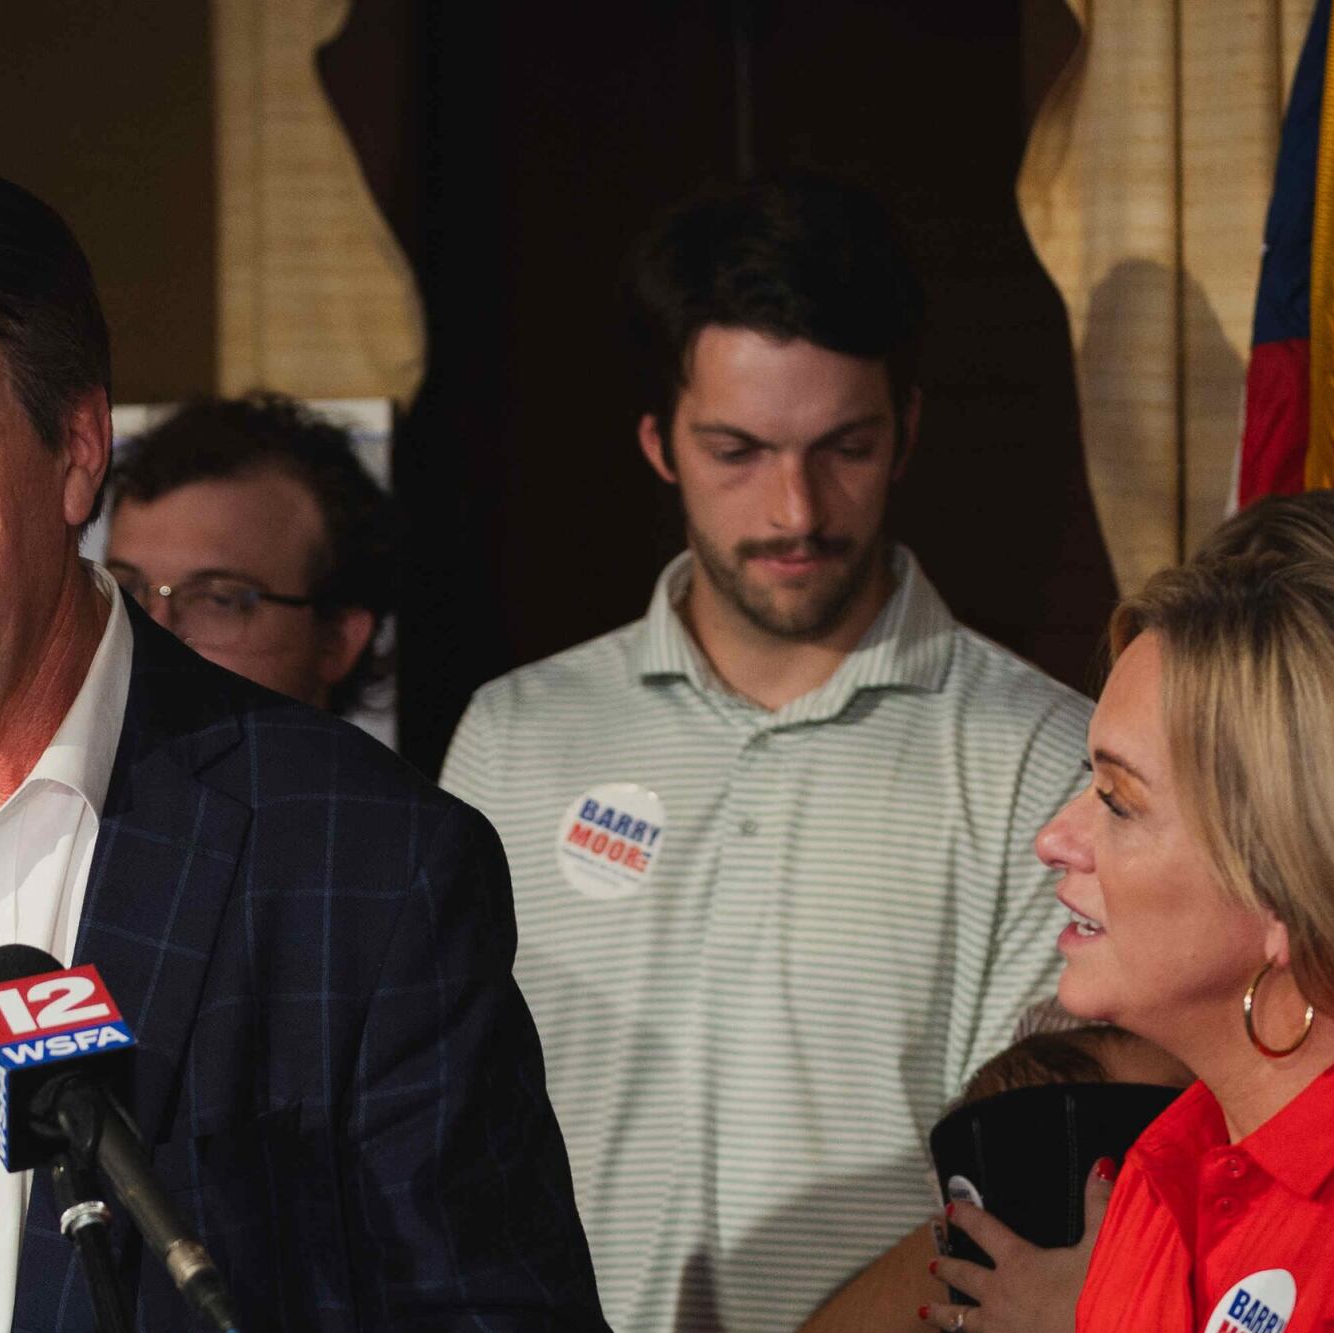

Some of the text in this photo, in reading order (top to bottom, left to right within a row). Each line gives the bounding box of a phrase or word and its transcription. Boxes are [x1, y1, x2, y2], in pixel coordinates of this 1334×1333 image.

[579, 799, 660, 846] BARRY
[567, 823, 652, 873] MOORE
[2, 1026, 130, 1064] WSFA
